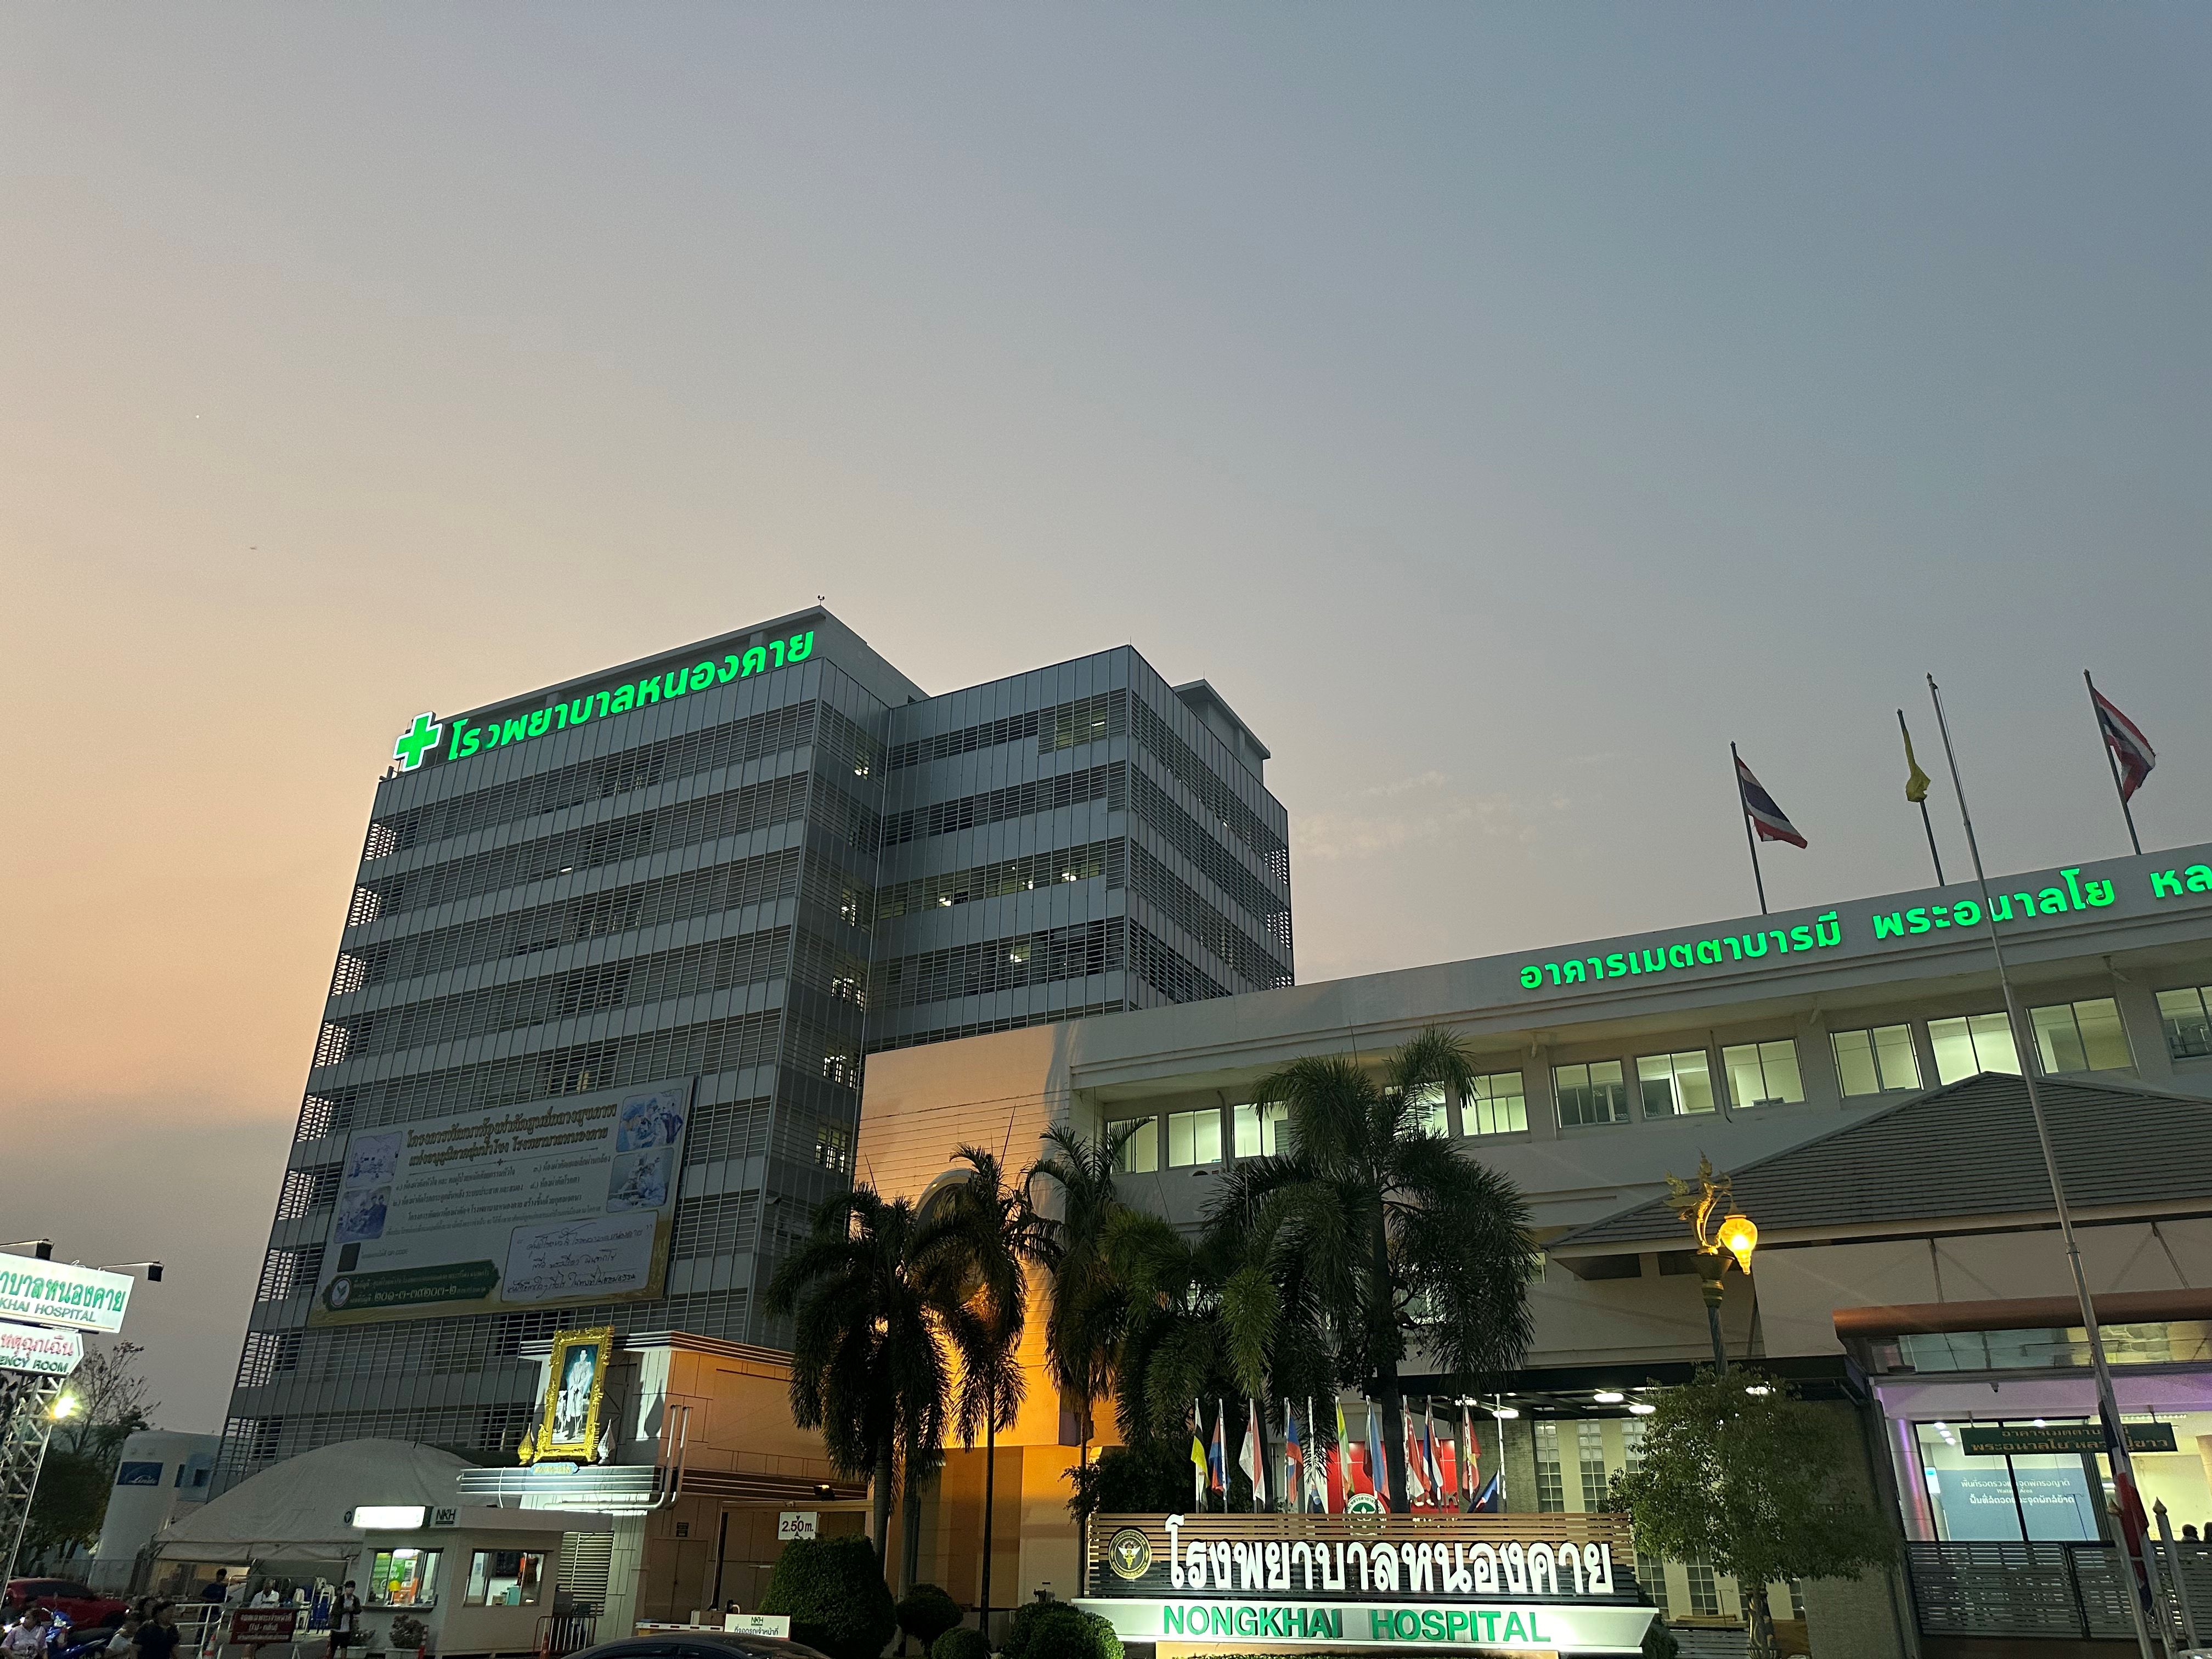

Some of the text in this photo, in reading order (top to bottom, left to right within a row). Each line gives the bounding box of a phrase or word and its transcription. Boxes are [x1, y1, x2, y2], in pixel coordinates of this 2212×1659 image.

[1520, 911, 1841, 989] อาคารเมตตาบารมี
[1872, 868, 2115, 939] พระอนาลโย
[512, 1127, 608, 1152] โรงพยาบาลหนองคาย
[0, 1270, 126, 1312] าบาลหนองคาย
[35, 1303, 96, 1322] HOSPITAL
[32, 1359, 69, 1372] ROOM
[436, 1509, 457, 1520] NKH
[1165, 1514, 1614, 1593] โรงพยาบาลหนองคาย
[1164, 1605, 1551, 1643] NONGKHAI HOSPITAL
